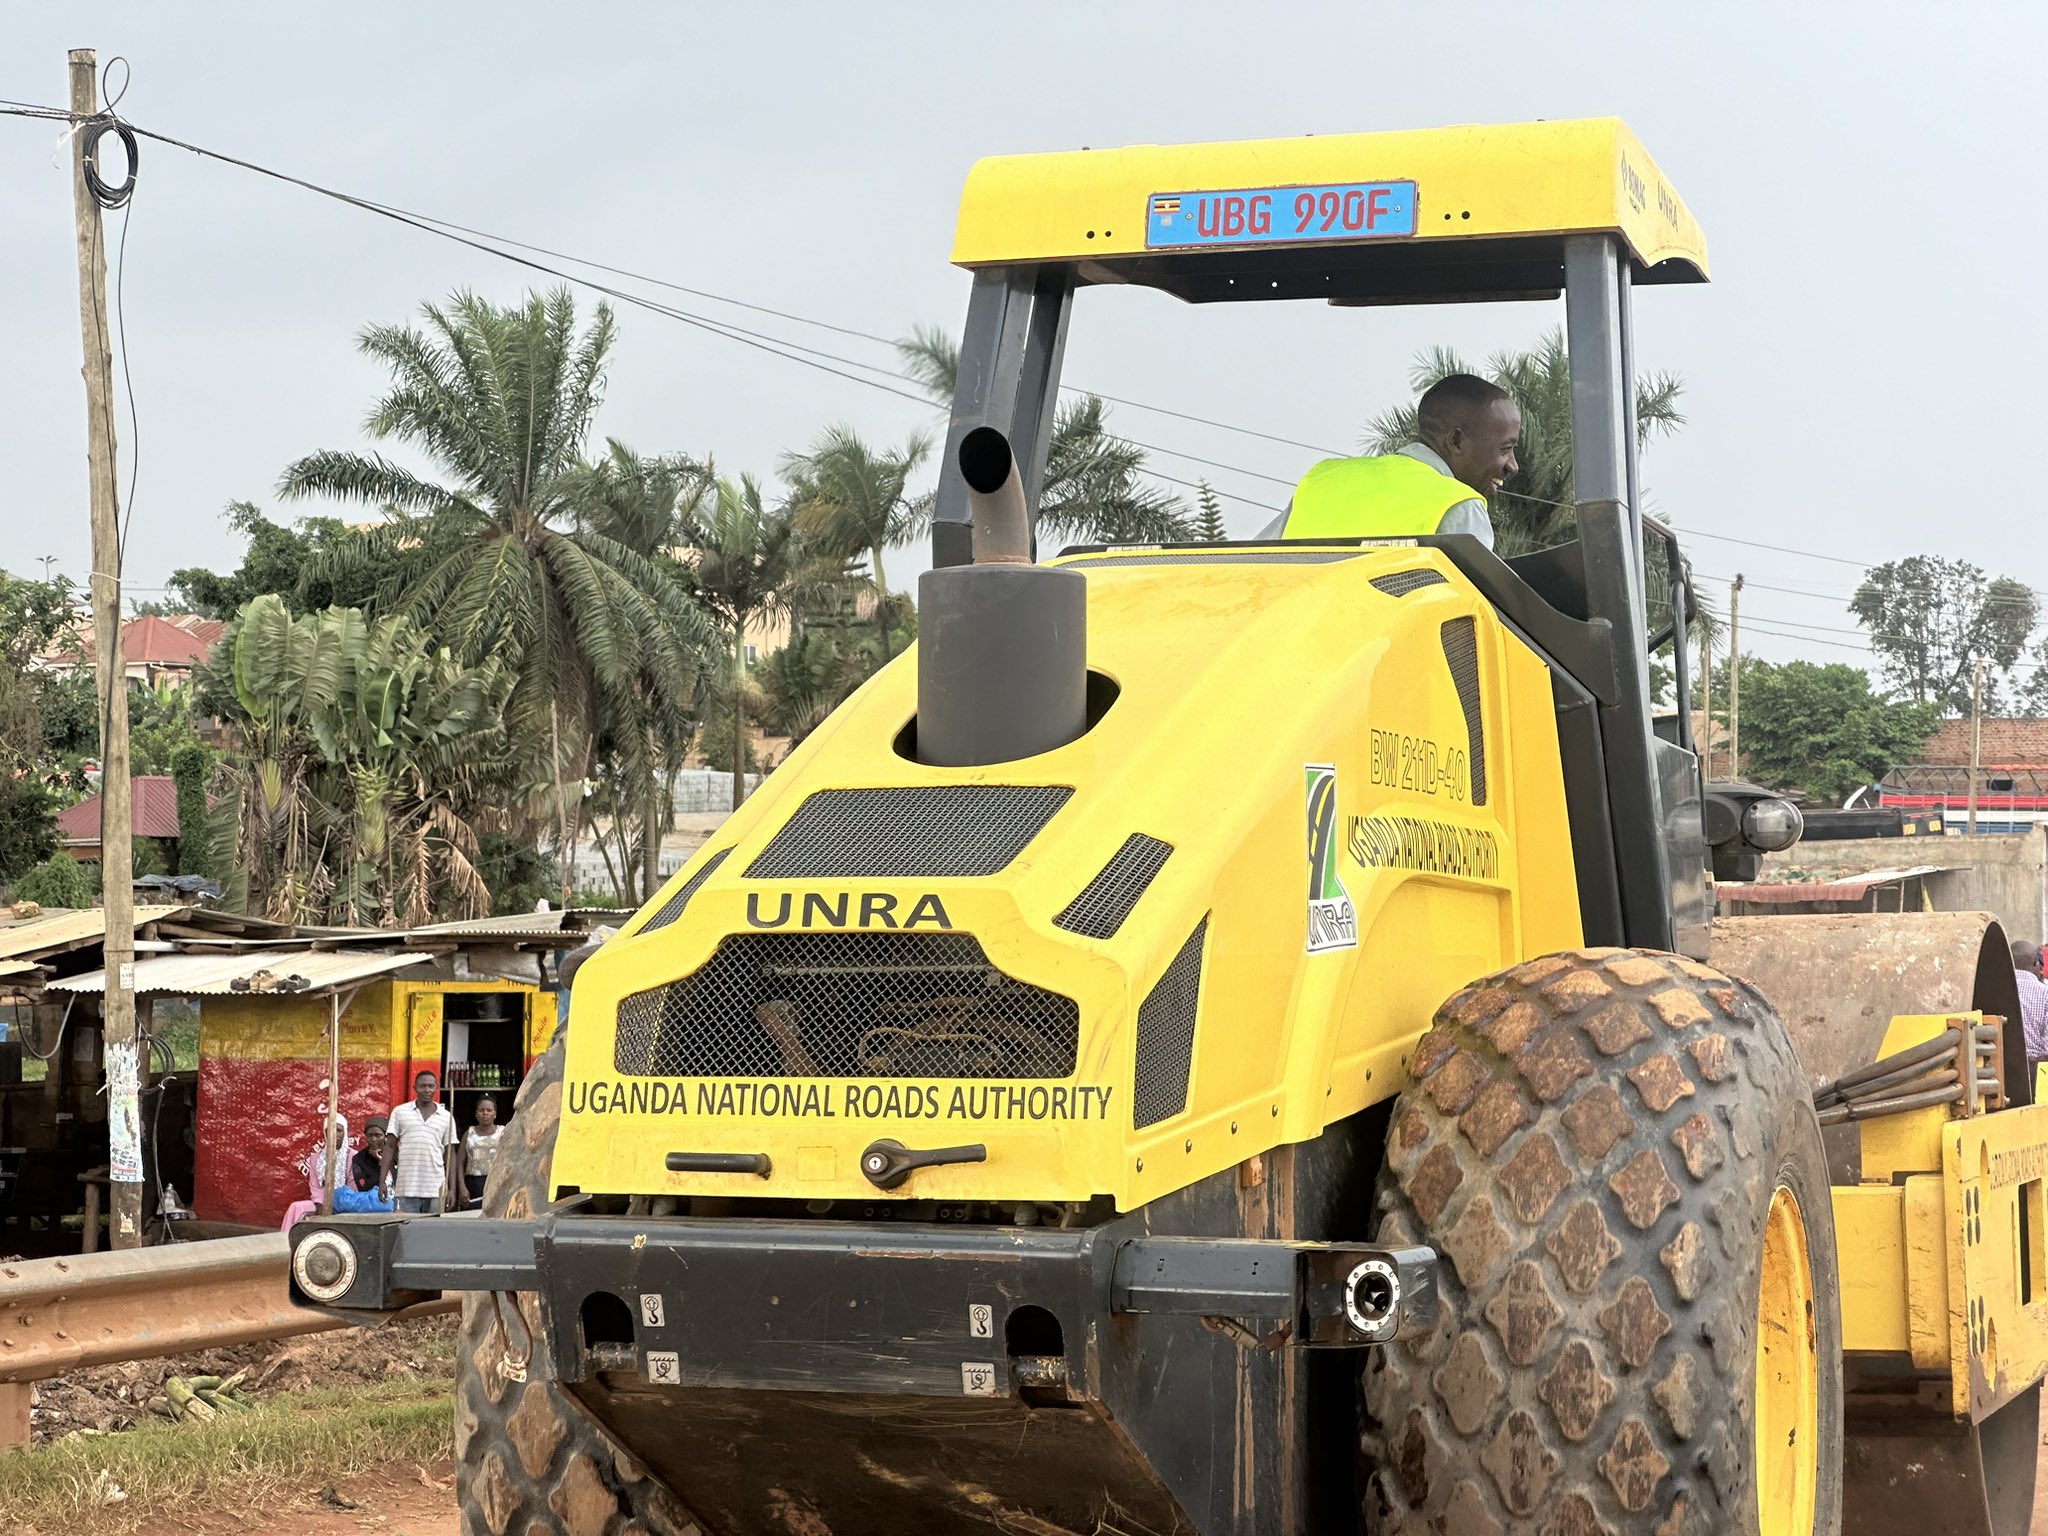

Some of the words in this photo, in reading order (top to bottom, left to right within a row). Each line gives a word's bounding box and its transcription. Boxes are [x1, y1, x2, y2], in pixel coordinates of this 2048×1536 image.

[1197, 194, 1272, 238] UBG
[1294, 189, 1392, 233] 990F
[1657, 180, 1678, 233] UNRA
[1371, 728, 1399, 788] BW
[1402, 736, 1466, 801] 211D-40
[1348, 815, 1400, 868] UGANDA
[1391, 817, 1437, 872] NATIONAL
[1433, 821, 1461, 876] ROADS
[1458, 827, 1499, 880] AUTHORITY
[746, 893, 953, 930] UNRA
[1308, 901, 1356, 946] UNRA
[569, 1081, 687, 1116] UGANDA
[697, 1082, 836, 1117] NATIONAL
[845, 1085, 940, 1118] ROADS
[947, 1086, 1114, 1120] AUTHORITY
